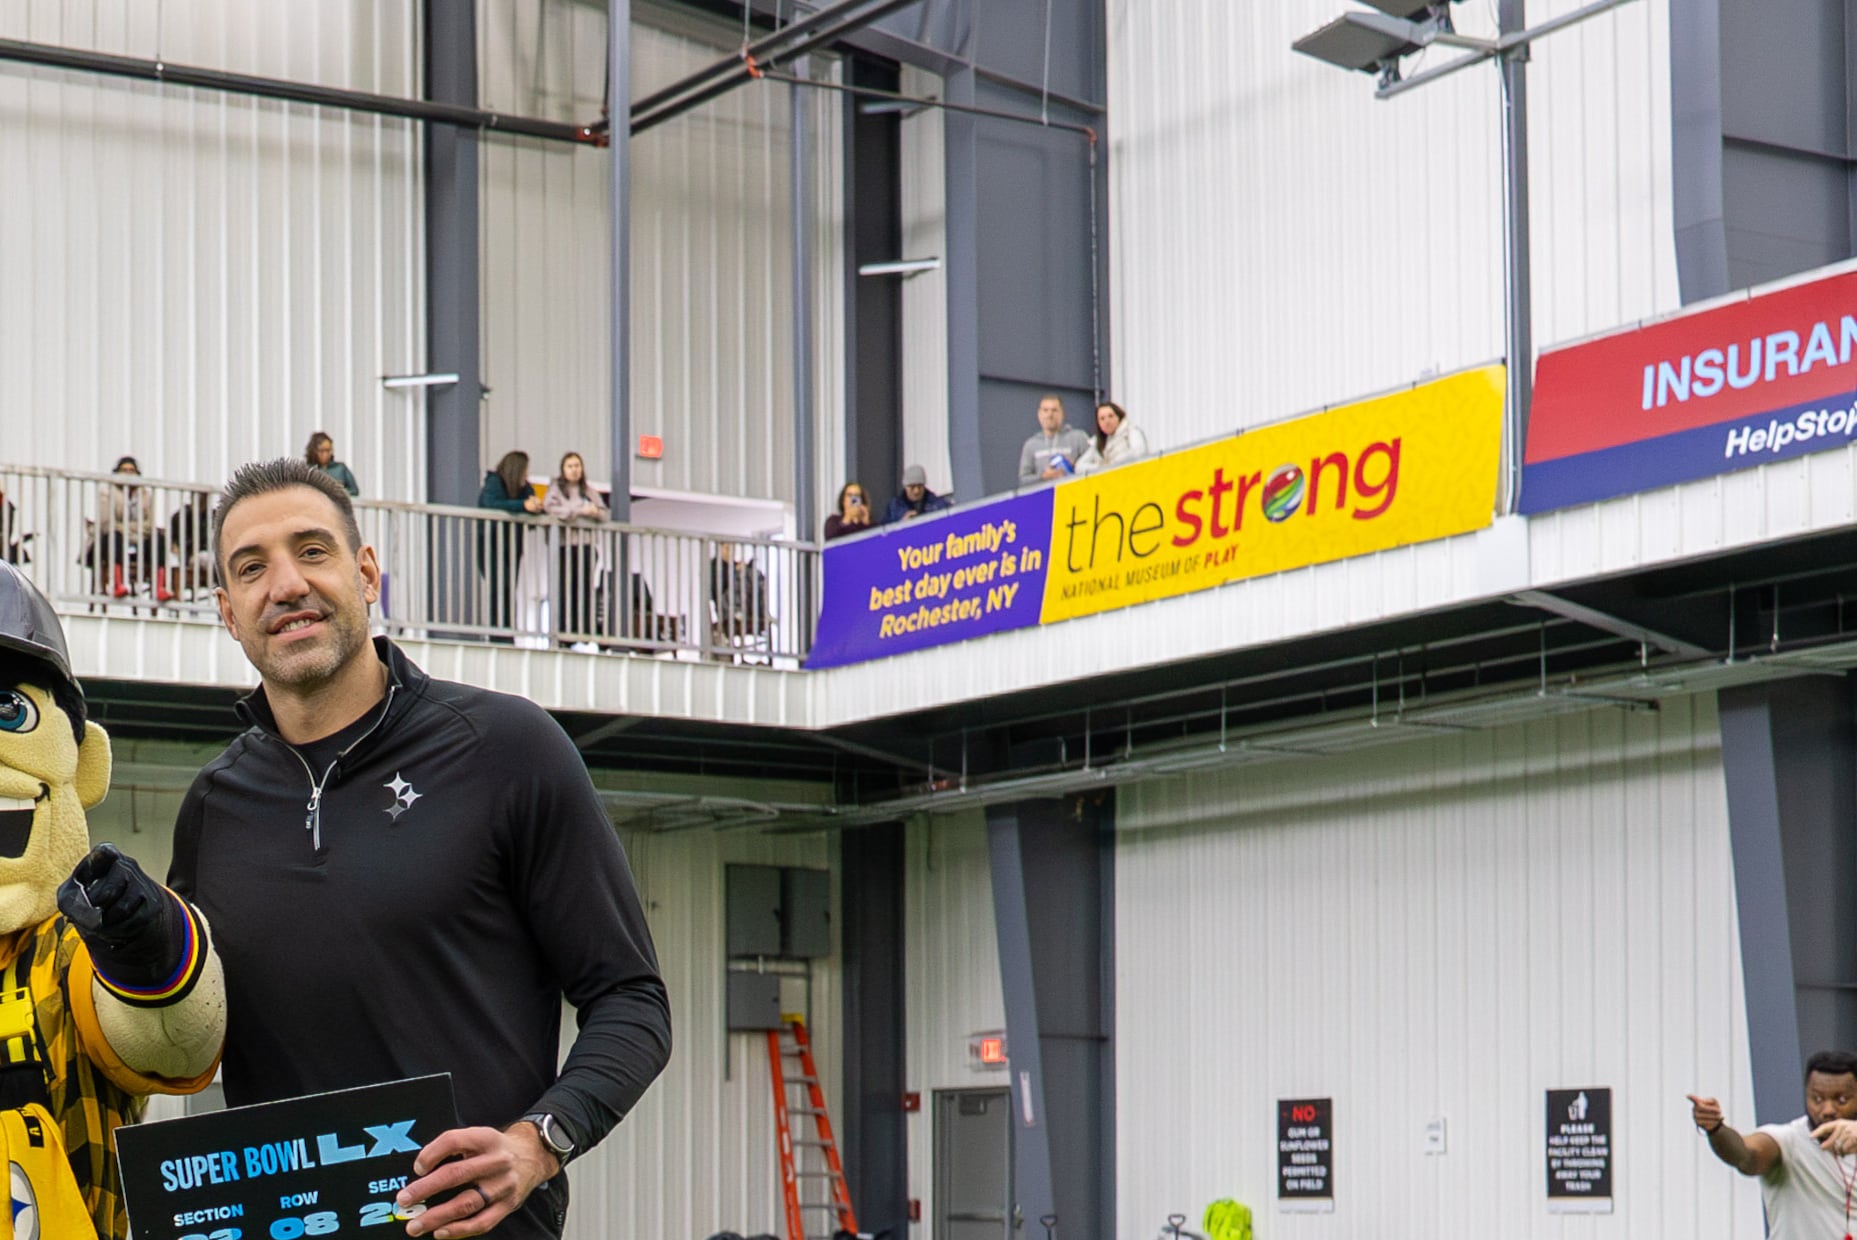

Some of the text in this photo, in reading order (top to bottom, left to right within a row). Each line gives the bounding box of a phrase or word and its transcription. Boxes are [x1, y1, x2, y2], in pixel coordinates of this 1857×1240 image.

[897, 519, 1017, 572] Your family's
[869, 546, 1042, 611] best day ever is in
[1060, 544, 1239, 601] NATIONAL MUSEUM OF PLAY
[879, 582, 1020, 639] Rochester, NY
[1292, 1105, 1316, 1122] NO
[1560, 1123, 1594, 1134] PLEASE
[160, 1119, 423, 1192] SUPER BOWL LX
[173, 1175, 409, 1227] SECTION ROW SEAT
[269, 1211, 340, 1240] 08
